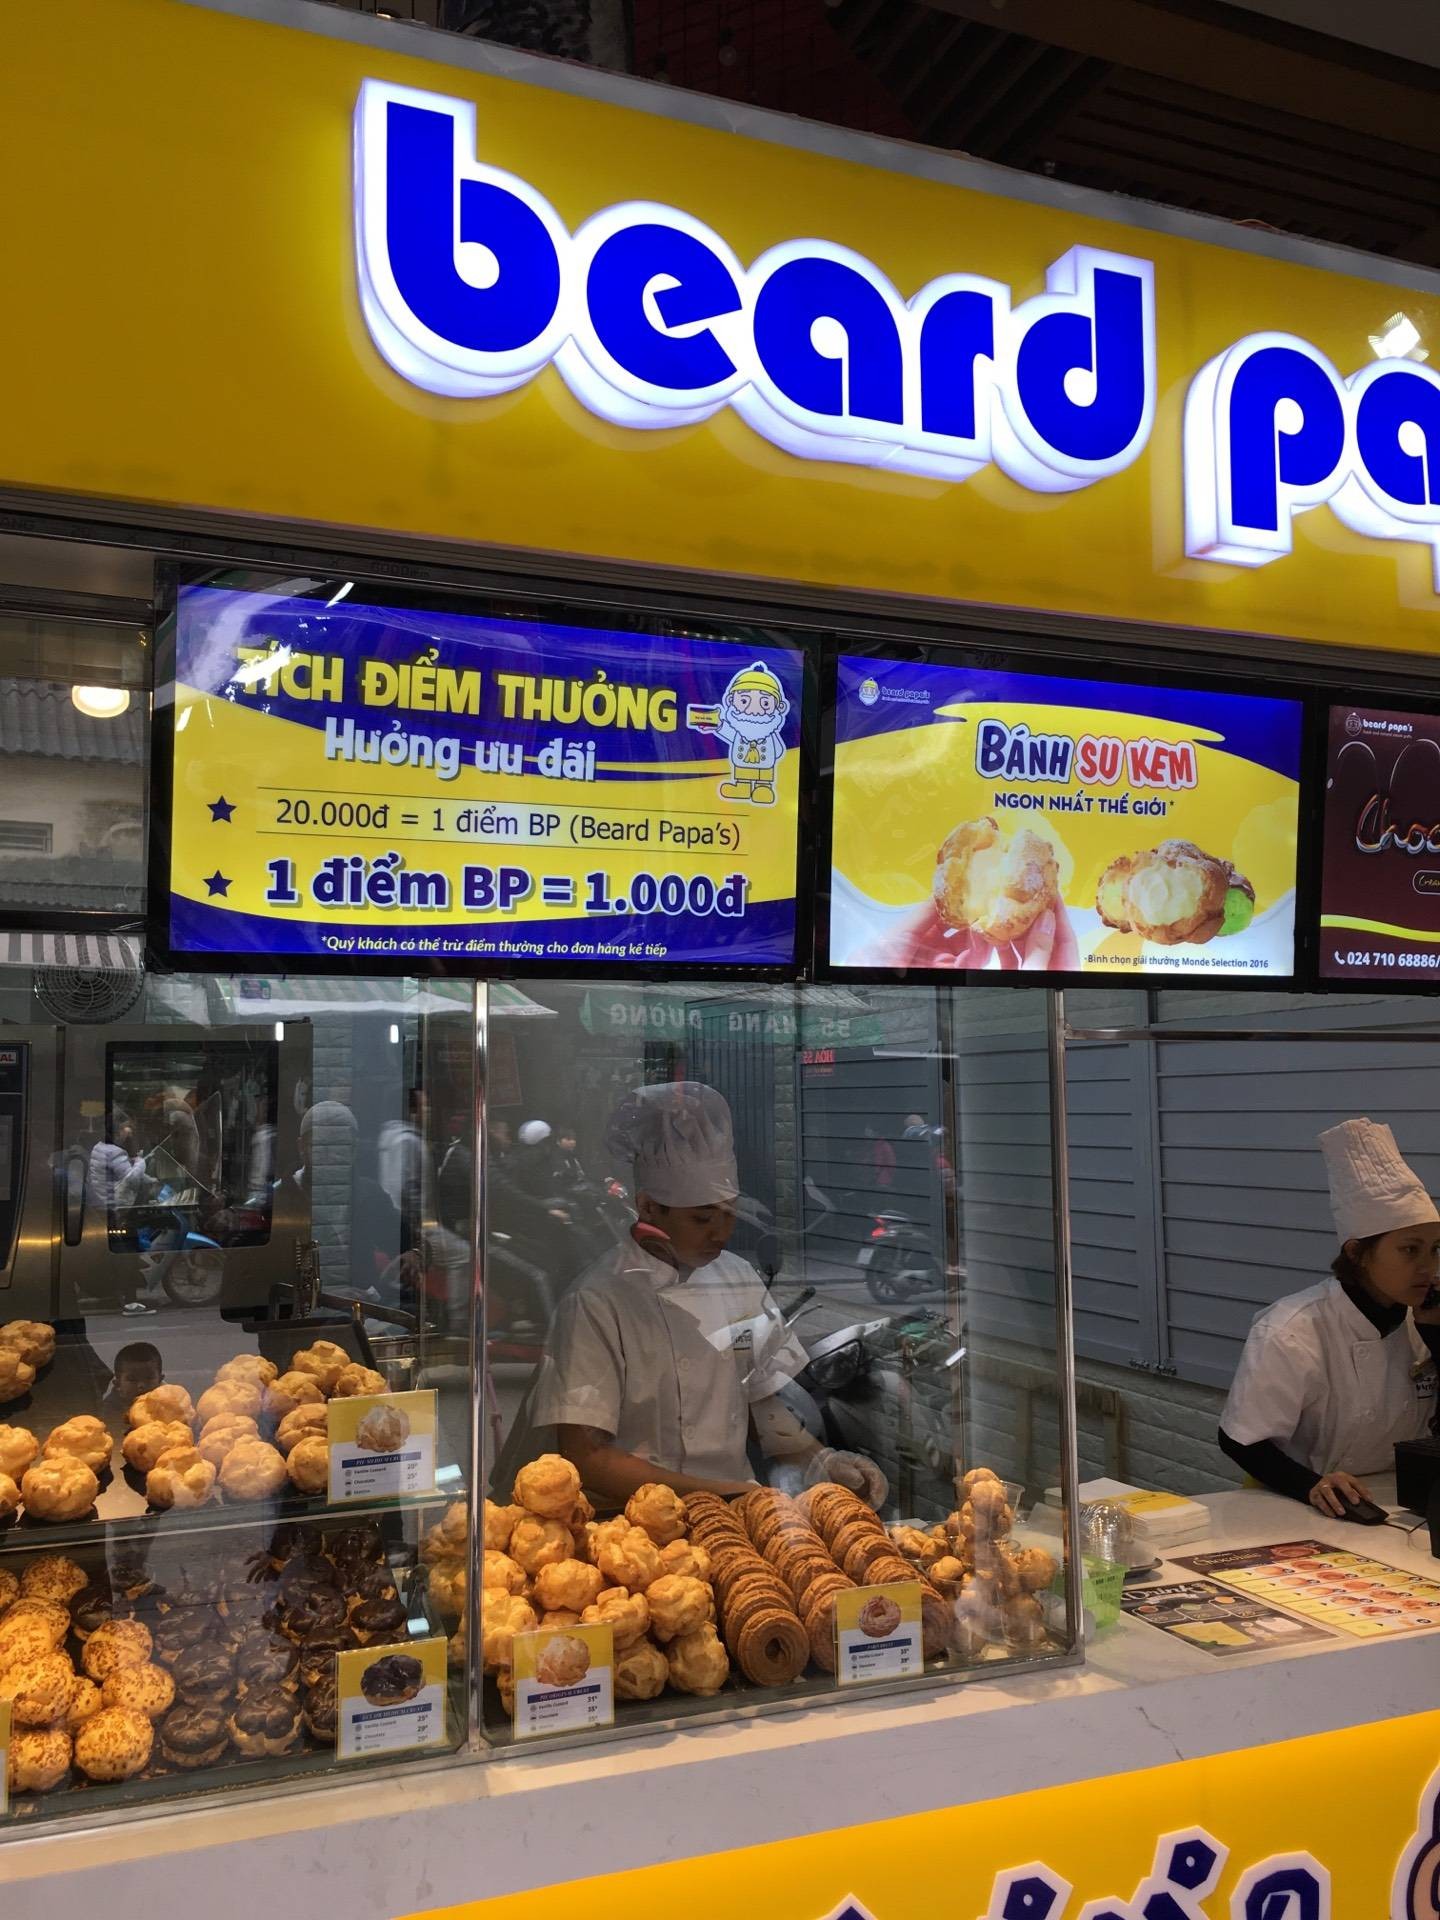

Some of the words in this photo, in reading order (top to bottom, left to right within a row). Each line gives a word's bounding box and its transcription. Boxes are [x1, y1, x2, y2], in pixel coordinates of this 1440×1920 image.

[370, 88, 1155, 475] beard
[362, 649, 481, 715] ĐIỂM
[497, 671, 677, 733] THƯỞNG
[1363, 719, 1387, 729] beard
[1388, 723, 1413, 732] papa's
[325, 717, 460, 782] Hưởng
[475, 738, 524, 775] ưu
[537, 737, 596, 781] đãi
[979, 723, 1072, 780] BÁNH
[1078, 738, 1121, 781] SU
[1129, 740, 1195, 787] KEM
[995, 793, 1044, 809] NGON
[1049, 790, 1094, 812] NHẤT
[1098, 792, 1129, 814] THẾ
[1133, 797, 1166, 815] GIỚI
[275, 799, 390, 830] 20.000đ
[432, 811, 444, 831] 1
[456, 804, 518, 835] điểm
[529, 813, 561, 838] BP
[569, 812, 649, 845] (Beard
[658, 818, 741, 852] Papa's)
[266, 858, 299, 904] 1
[312, 852, 449, 907] điểm
[463, 865, 532, 911] BP
[585, 871, 748, 918] 1.000đ
[1419, 875, 1440, 887] Crea
[358, 936, 397, 950] khách
[401, 938, 415, 950] có
[419, 936, 441, 951] thể
[443, 938, 463, 951] trừ
[466, 938, 495, 952] điểm
[499, 940, 544, 955] thưởng
[547, 941, 568, 953] cho
[571, 942, 594, 954] đơn
[597, 942, 626, 956] hàng
[645, 942, 667, 957] tiếp
[1110, 955, 1131, 965] chọn
[1133, 955, 1147, 966] giải
[1149, 956, 1180, 967] thưởng
[1182, 957, 1210, 966] Monde
[1211, 958, 1248, 967] Selection
[1250, 959, 1269, 968] 2016
[1347, 951, 1370, 965] 024
[1373, 952, 1395, 966] 710
